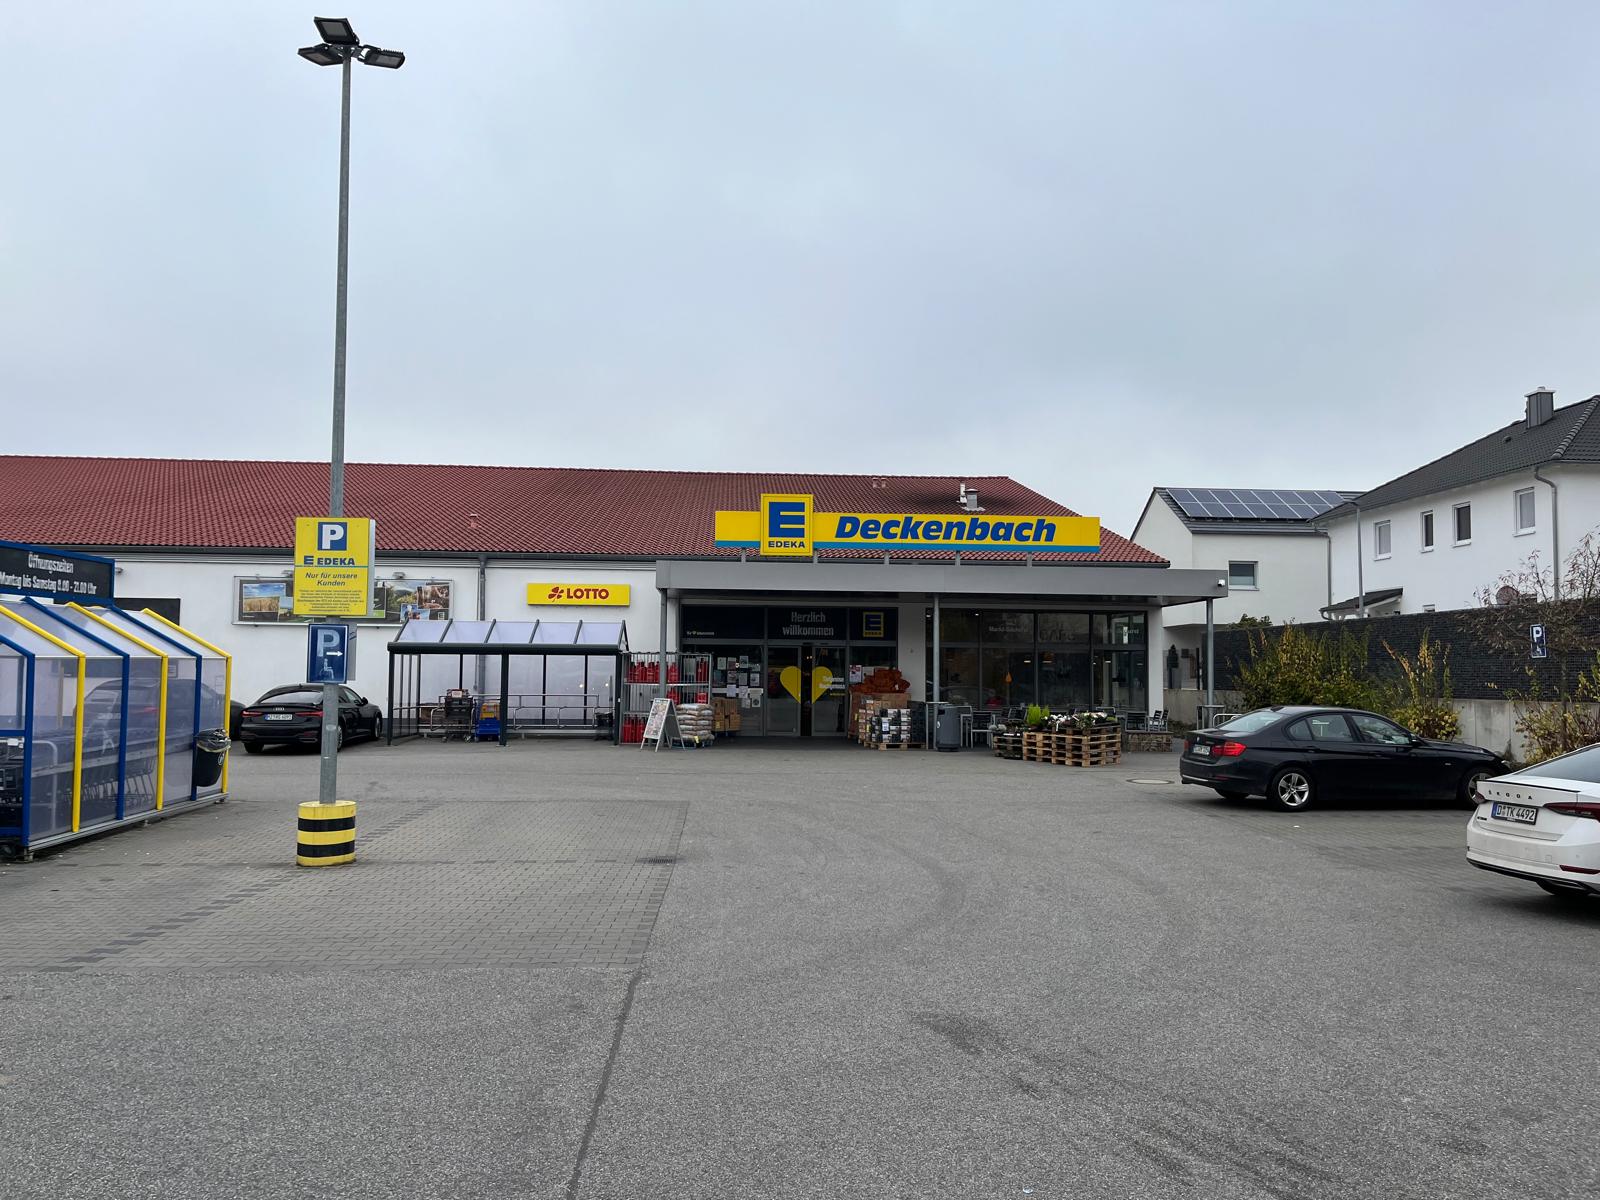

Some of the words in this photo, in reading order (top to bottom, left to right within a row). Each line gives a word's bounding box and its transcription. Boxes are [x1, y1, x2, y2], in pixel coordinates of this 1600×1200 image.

[768, 502, 805, 537] E
[322, 524, 344, 550] P
[835, 516, 1056, 542] Deckenbach
[28, 552, 74, 574] Öffnungszeiten
[317, 557, 355, 566] EDEKA
[0, 571, 22, 589] Montag
[22, 574, 32, 588] bis
[32, 576, 57, 593] Samstag
[73, 581, 87, 593] 21.00
[87, 582, 97, 595] Uhr
[305, 571, 318, 579] Nur
[320, 571, 331, 579] für
[567, 588, 609, 600] LOTTO
[791, 611, 826, 623] Herzlich
[782, 624, 834, 636] willkommen
[1532, 626, 1543, 643] P
[316, 629, 340, 657] P
[1496, 805, 1502, 816] D
[1506, 806, 1516, 818] TK
[1516, 808, 1535, 821] 4492
